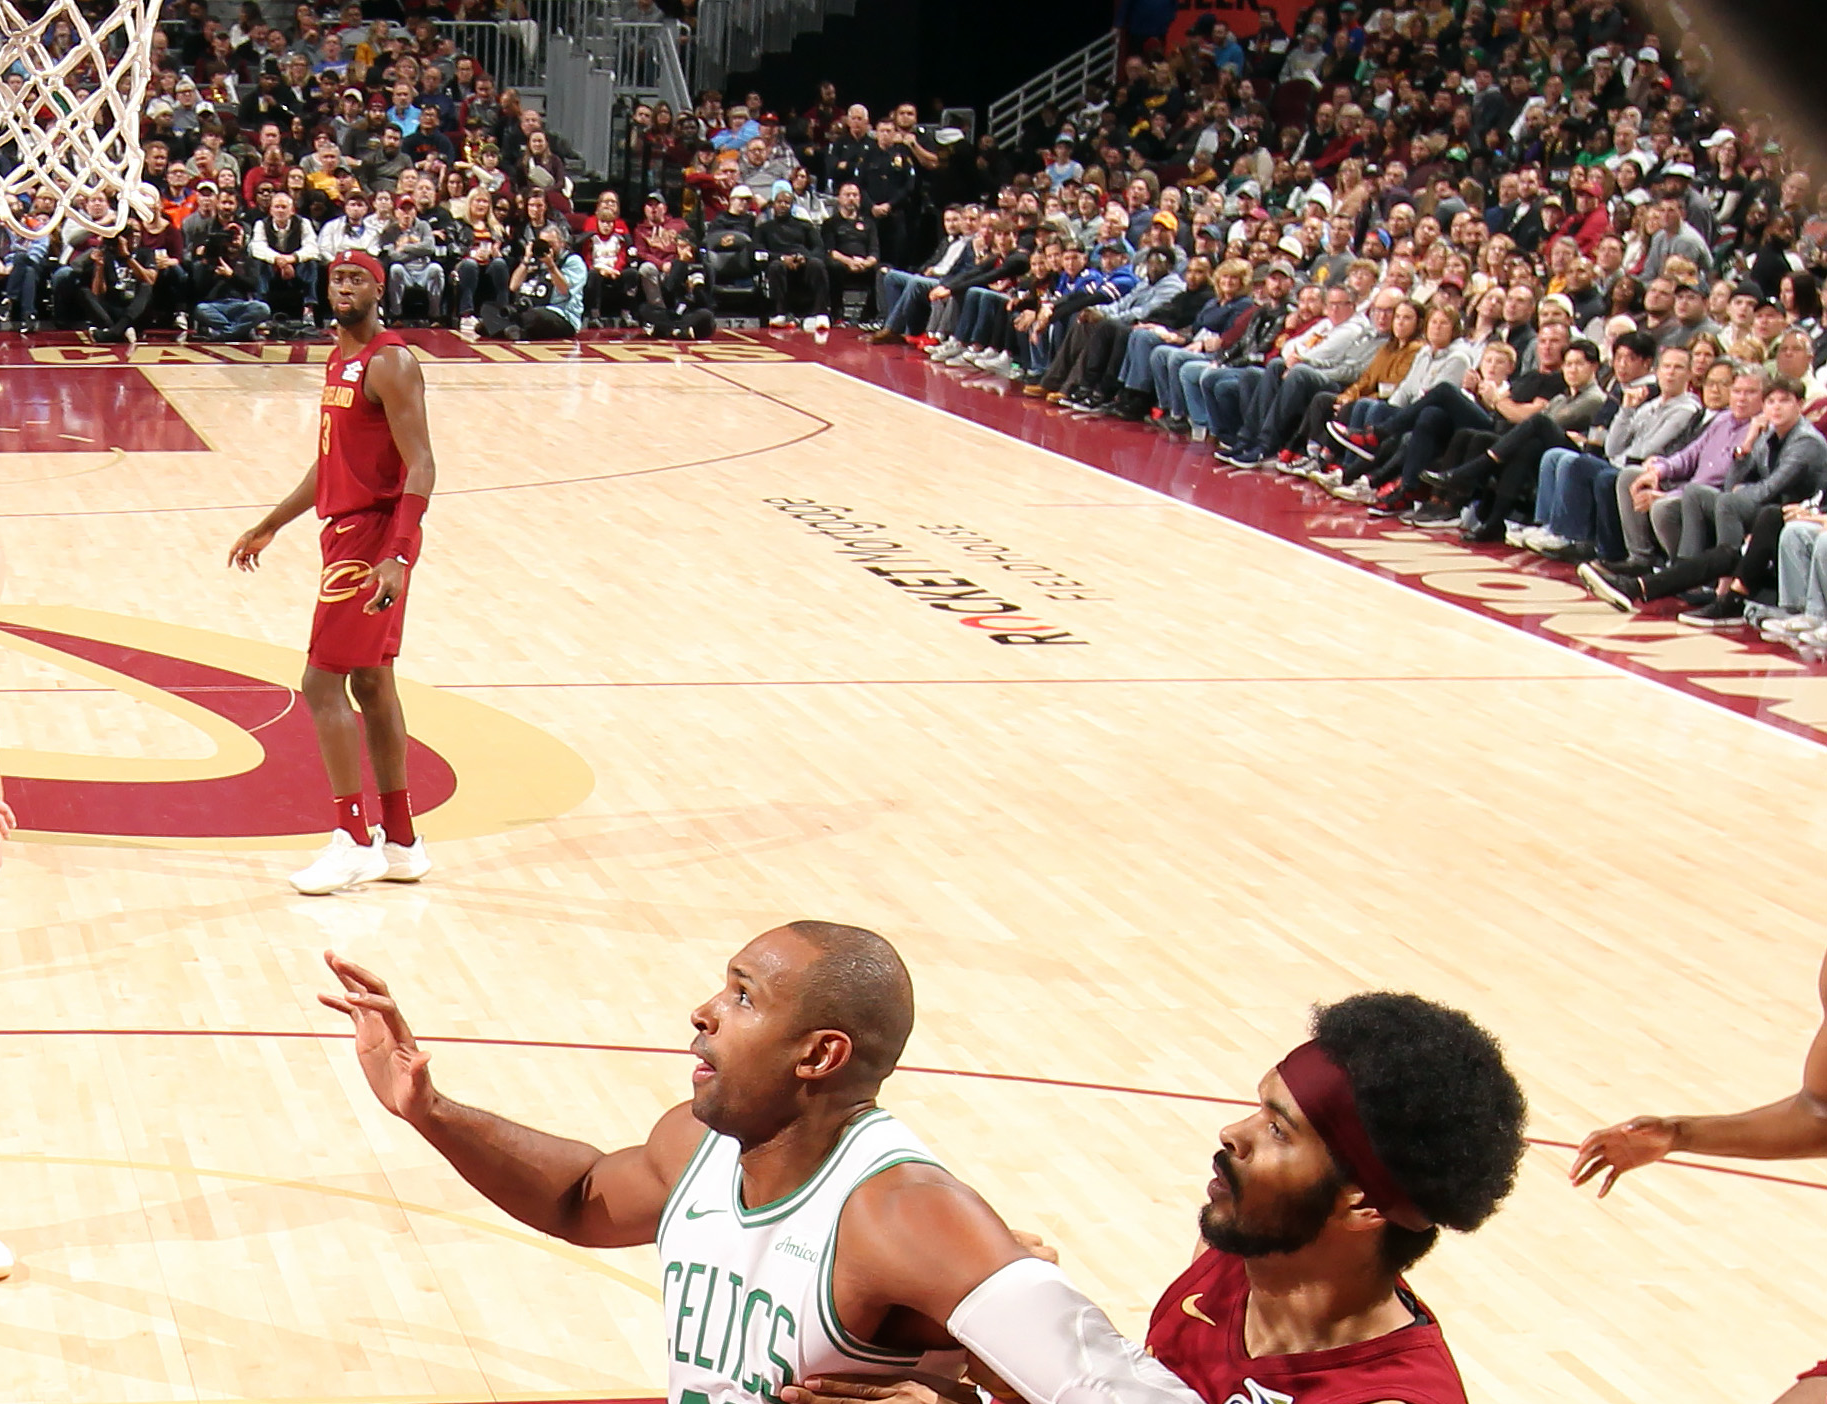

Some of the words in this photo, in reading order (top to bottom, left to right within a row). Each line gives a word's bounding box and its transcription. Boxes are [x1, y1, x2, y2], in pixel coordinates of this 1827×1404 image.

[28, 344, 796, 364] CAVLIERS
[917, 524, 1115, 601] FIELDHOUSE
[774, 1235, 819, 1263] Amica
